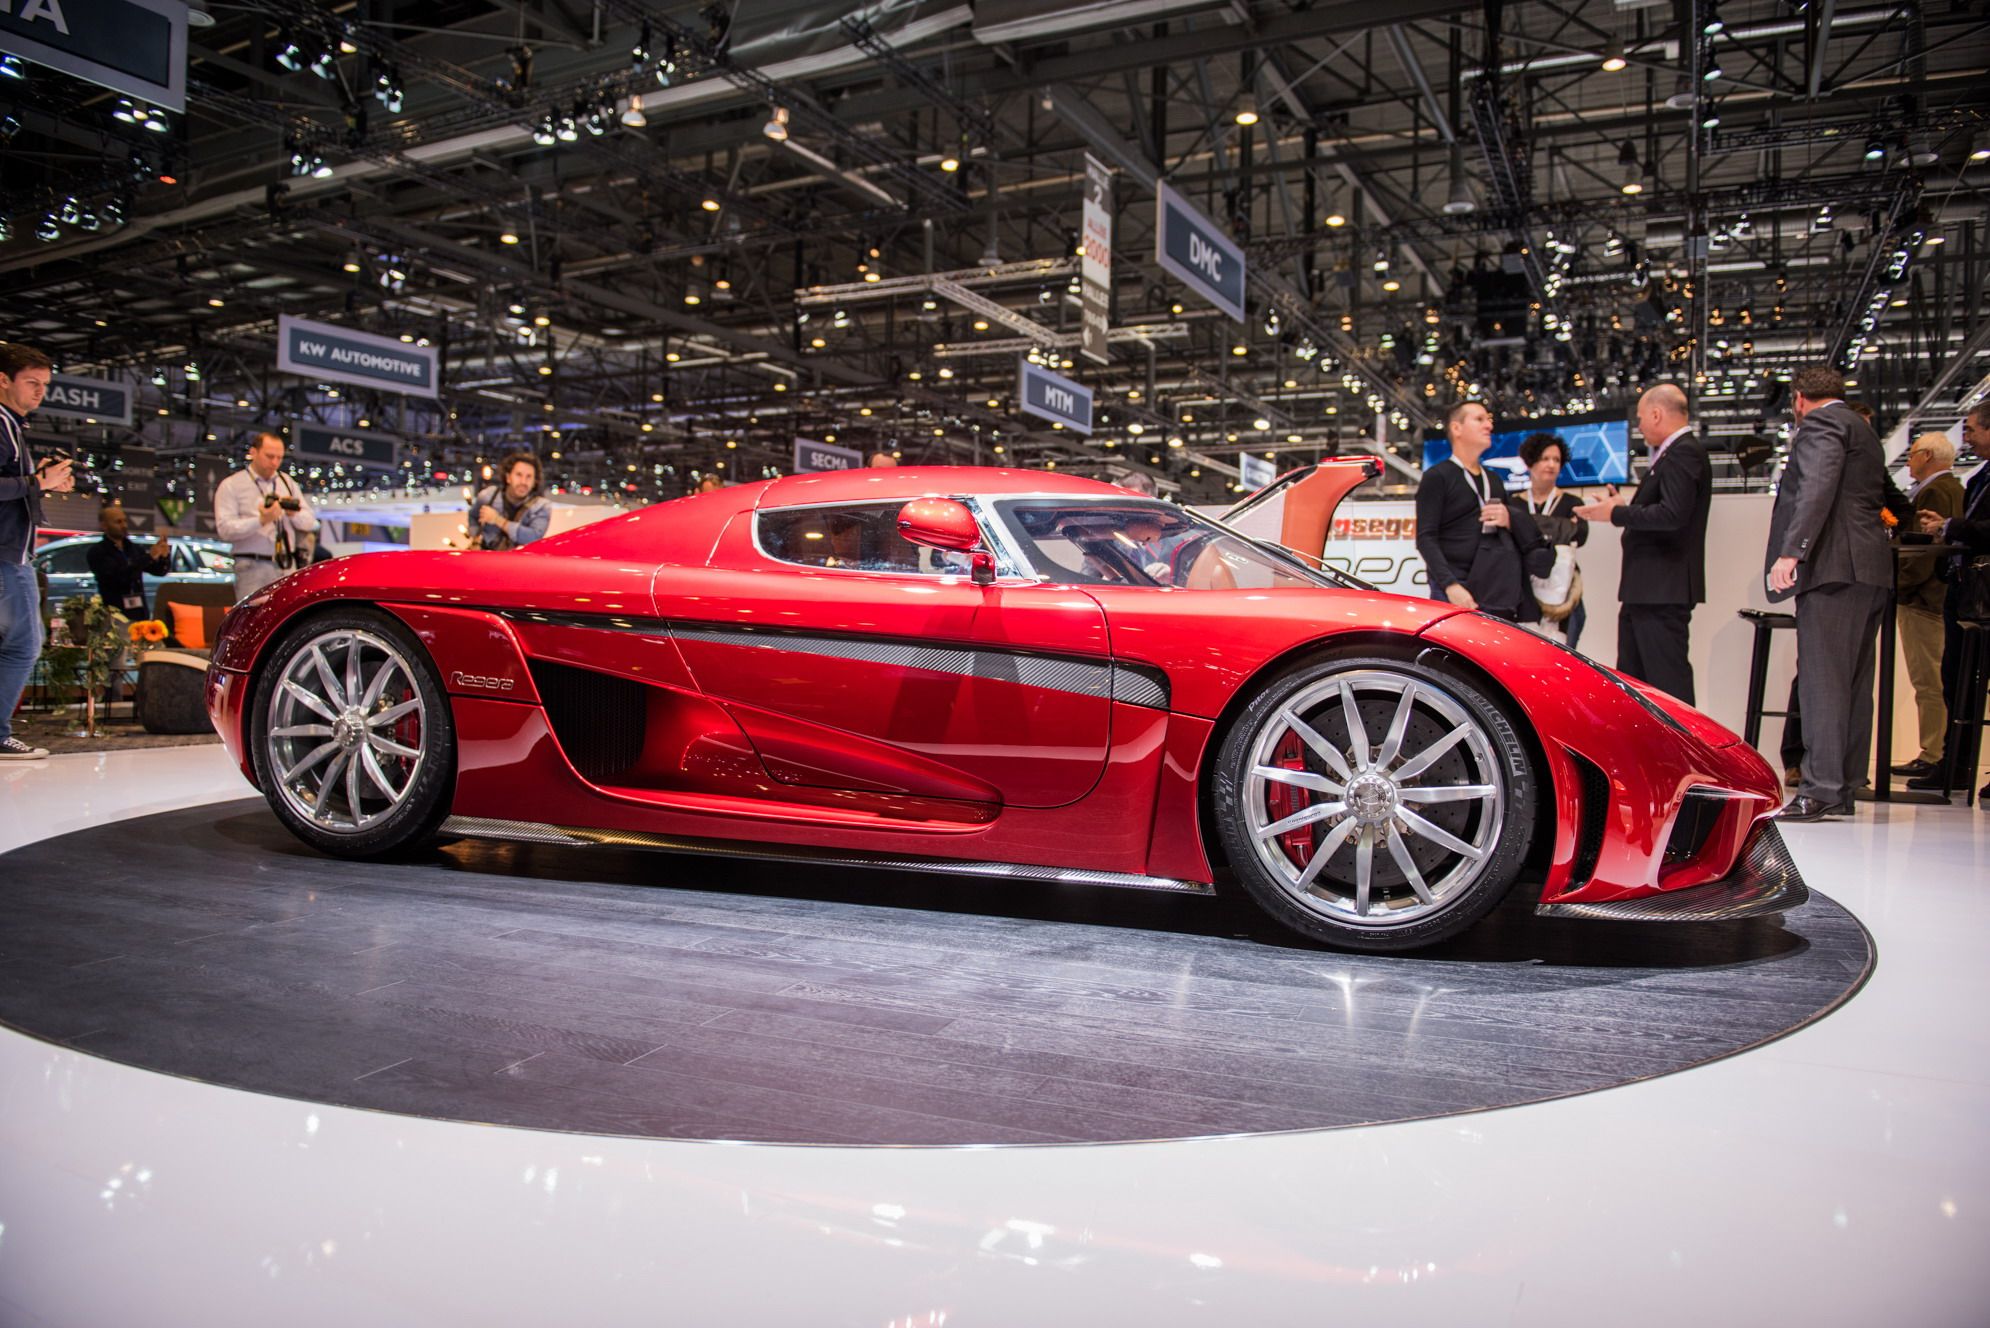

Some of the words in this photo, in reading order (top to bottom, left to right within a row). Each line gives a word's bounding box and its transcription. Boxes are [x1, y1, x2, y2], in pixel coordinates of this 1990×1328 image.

[1190, 231, 1222, 283] DMC
[299, 341, 327, 357] KW
[330, 347, 422, 378] AUTOMOTIVE
[44, 385, 99, 409] ASH
[1045, 384, 1073, 415] MTM
[329, 436, 364, 456] ACS
[810, 451, 848, 470] SECMA
[1329, 518, 1417, 540] gsegg
[449, 671, 515, 690] Regera
[1473, 693, 1528, 777] MICHELIN
